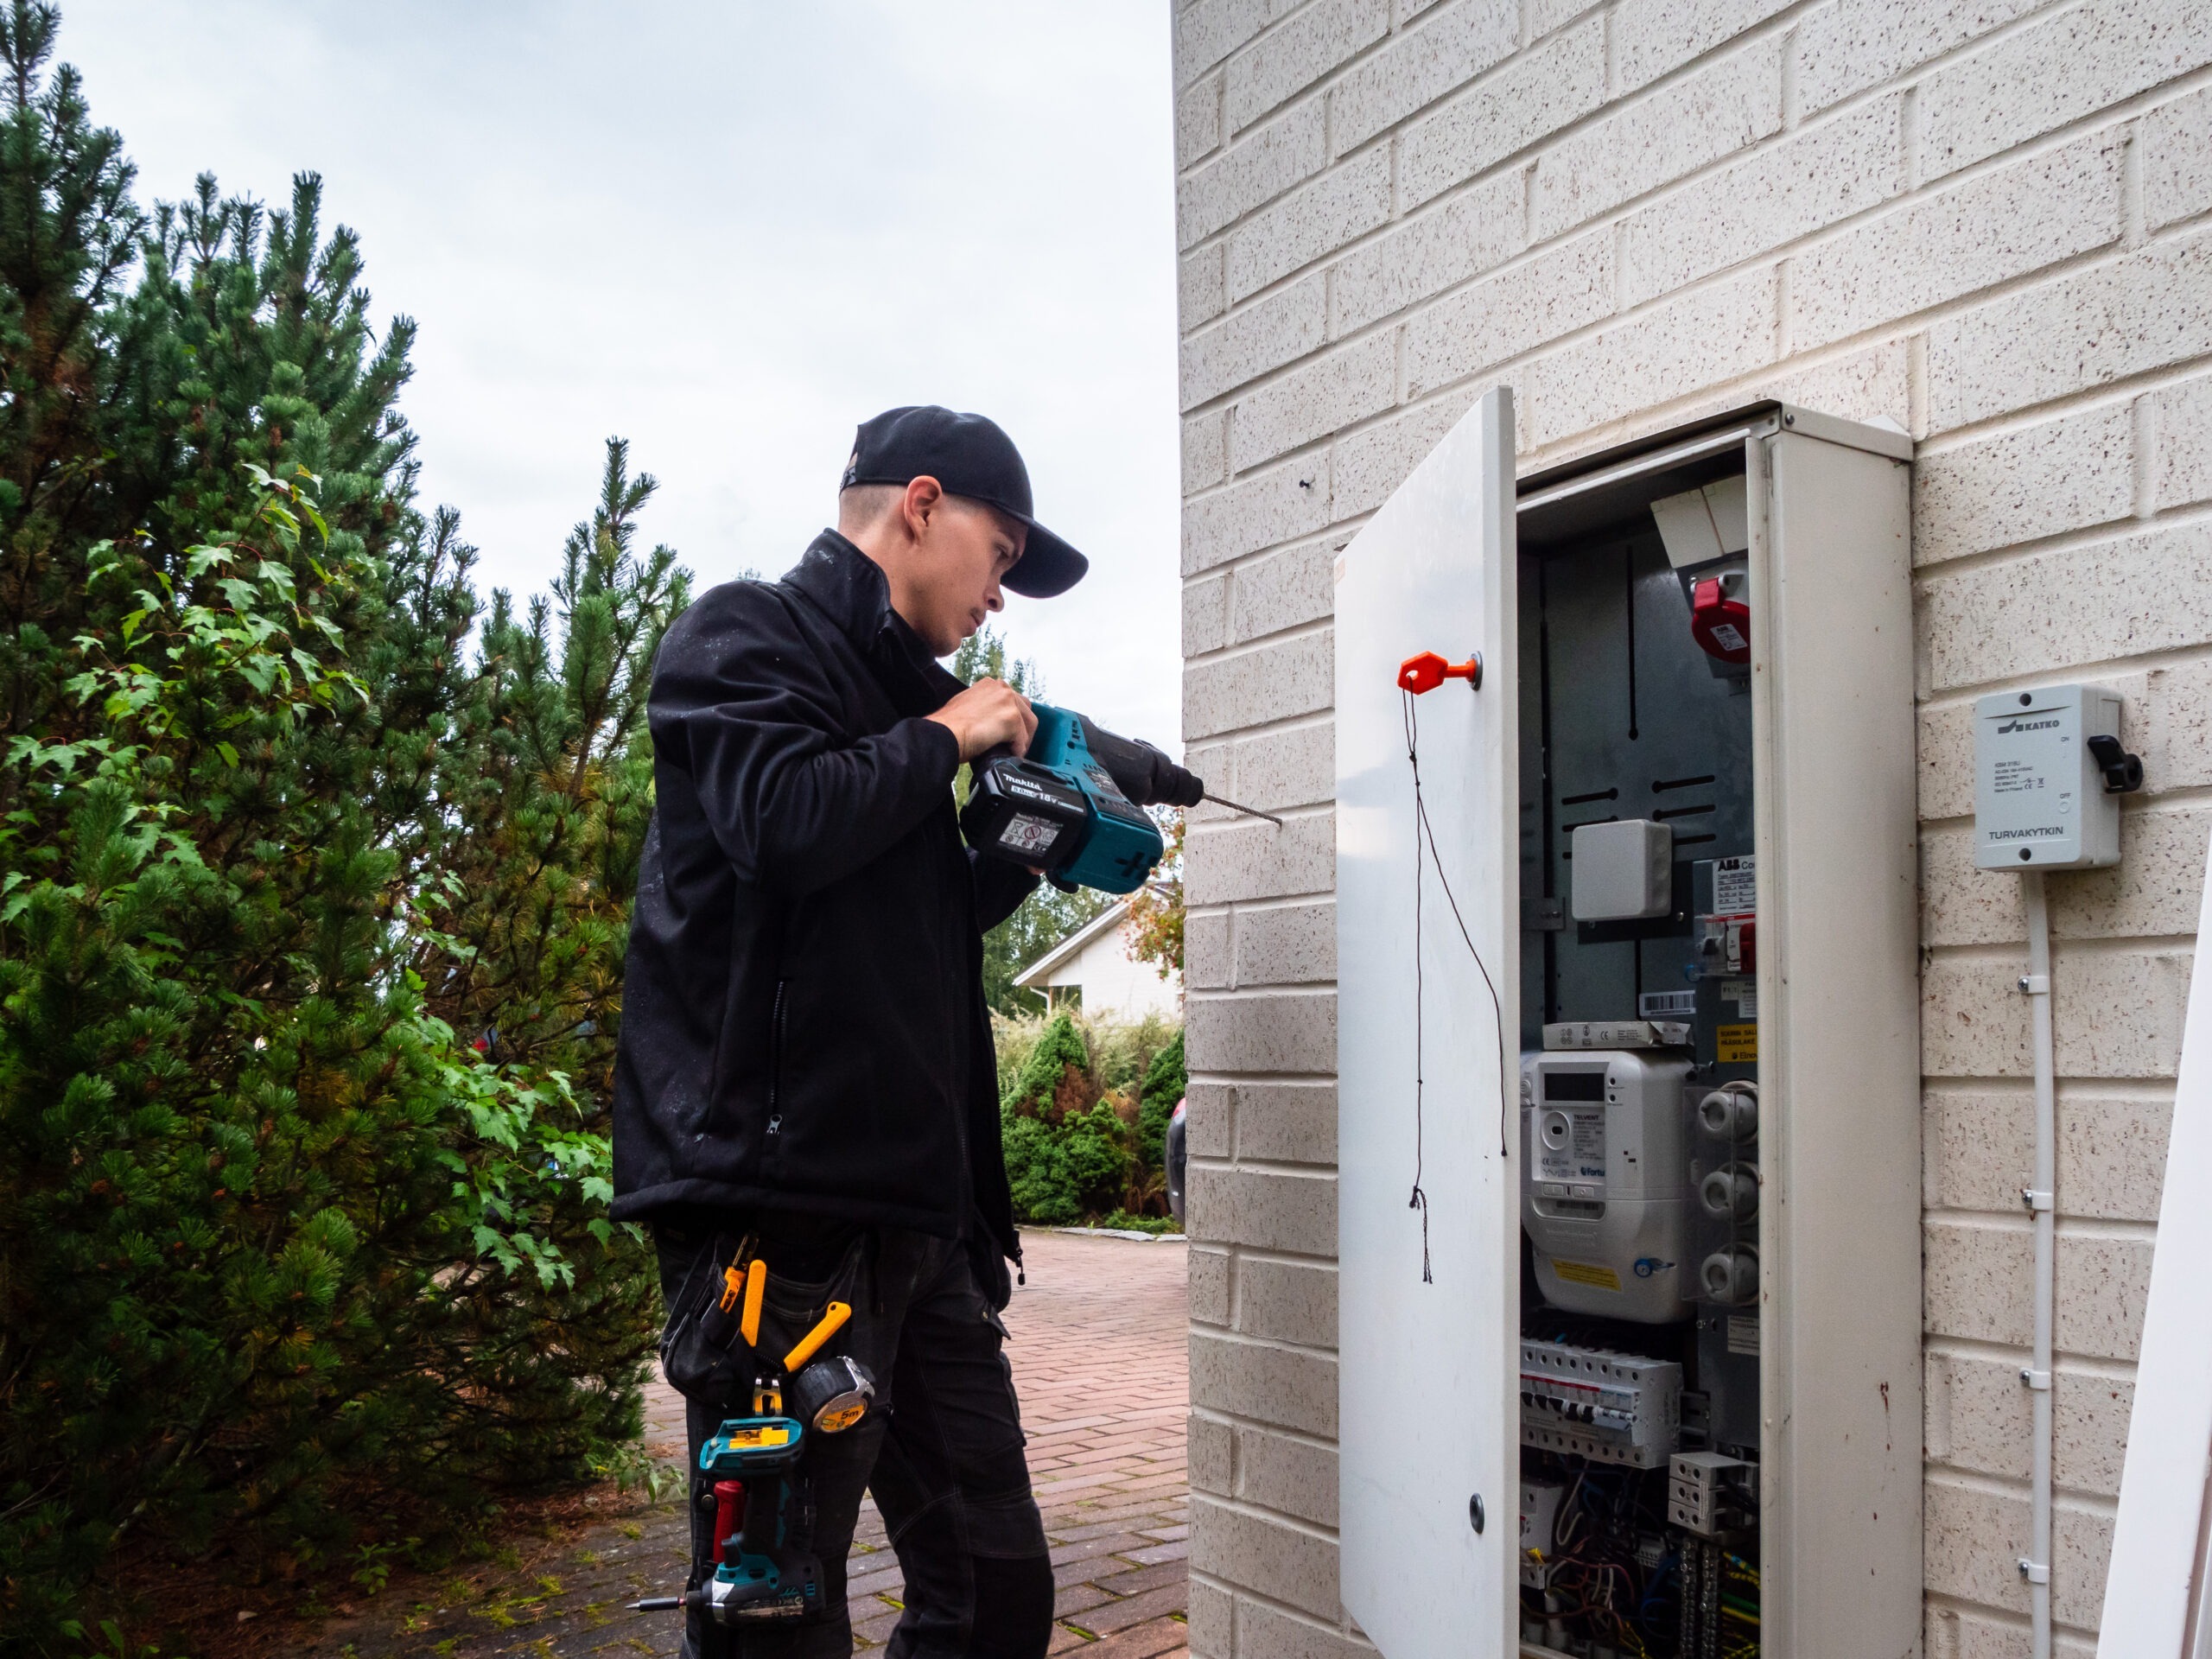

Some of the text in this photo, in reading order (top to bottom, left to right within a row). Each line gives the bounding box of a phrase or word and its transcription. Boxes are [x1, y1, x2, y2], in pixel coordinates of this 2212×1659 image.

[2025, 720, 2060, 731] KATKO
[1989, 826, 2063, 840] TURVAKYTKIN
[1718, 859, 1755, 872] ABB Co
[1587, 1167, 1605, 1176] Fortu
[841, 1410, 859, 1420] 5m
